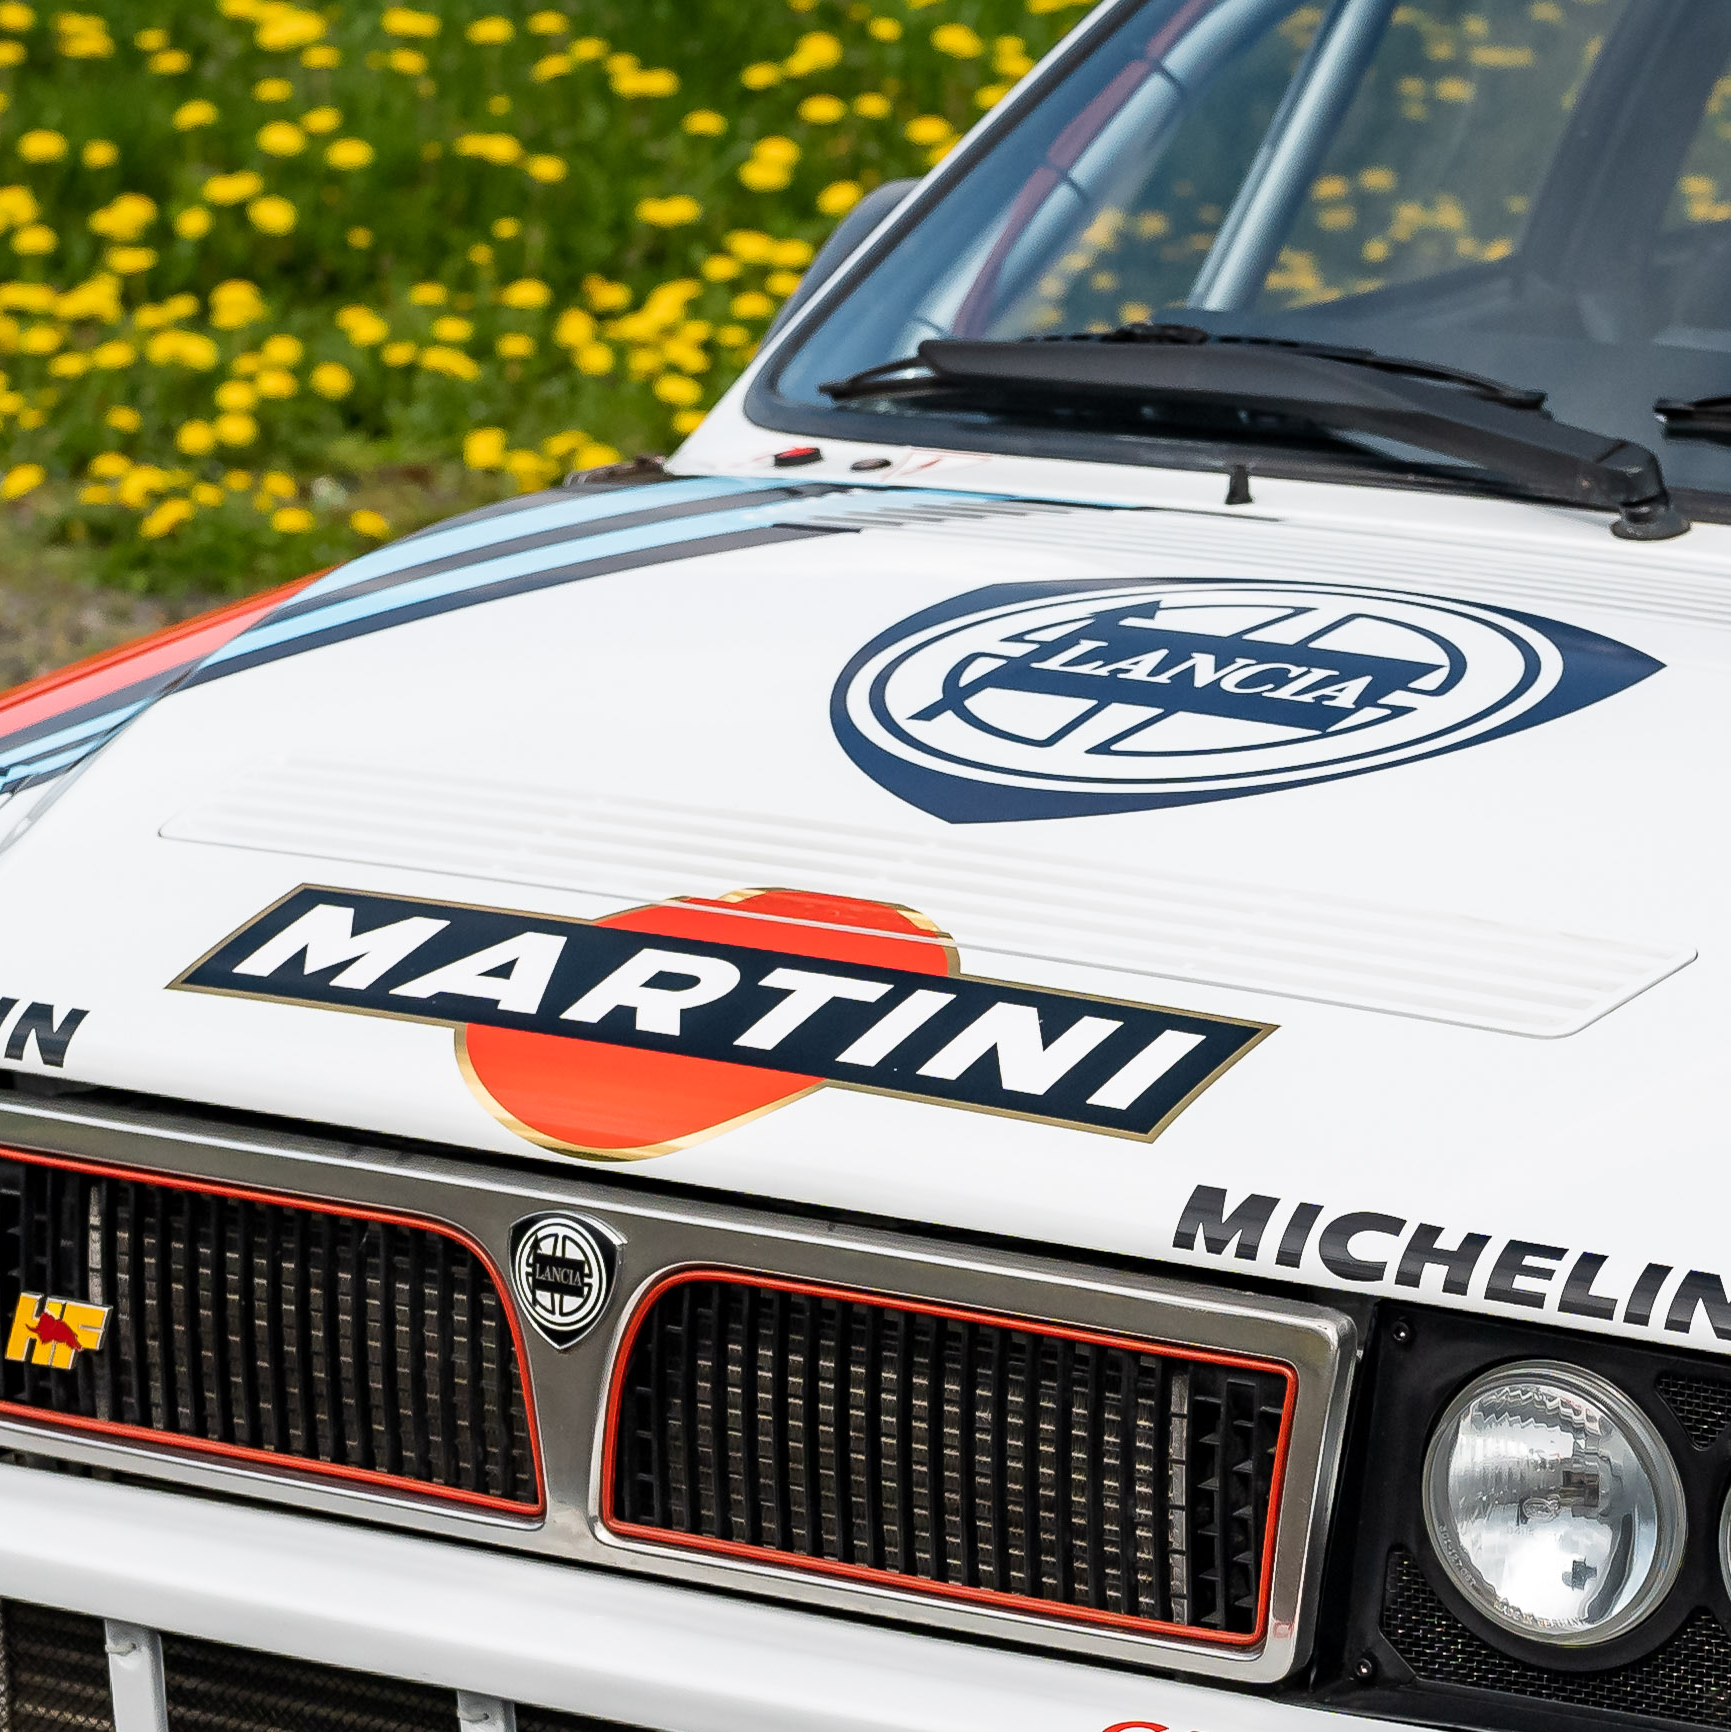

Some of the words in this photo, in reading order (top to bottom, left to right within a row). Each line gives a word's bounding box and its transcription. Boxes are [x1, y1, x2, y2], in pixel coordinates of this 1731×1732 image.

[1030, 638, 1380, 710] LANCIA
[232, 902, 1206, 1112] MARTINI
[535, 1262, 583, 1287] LANCIA
